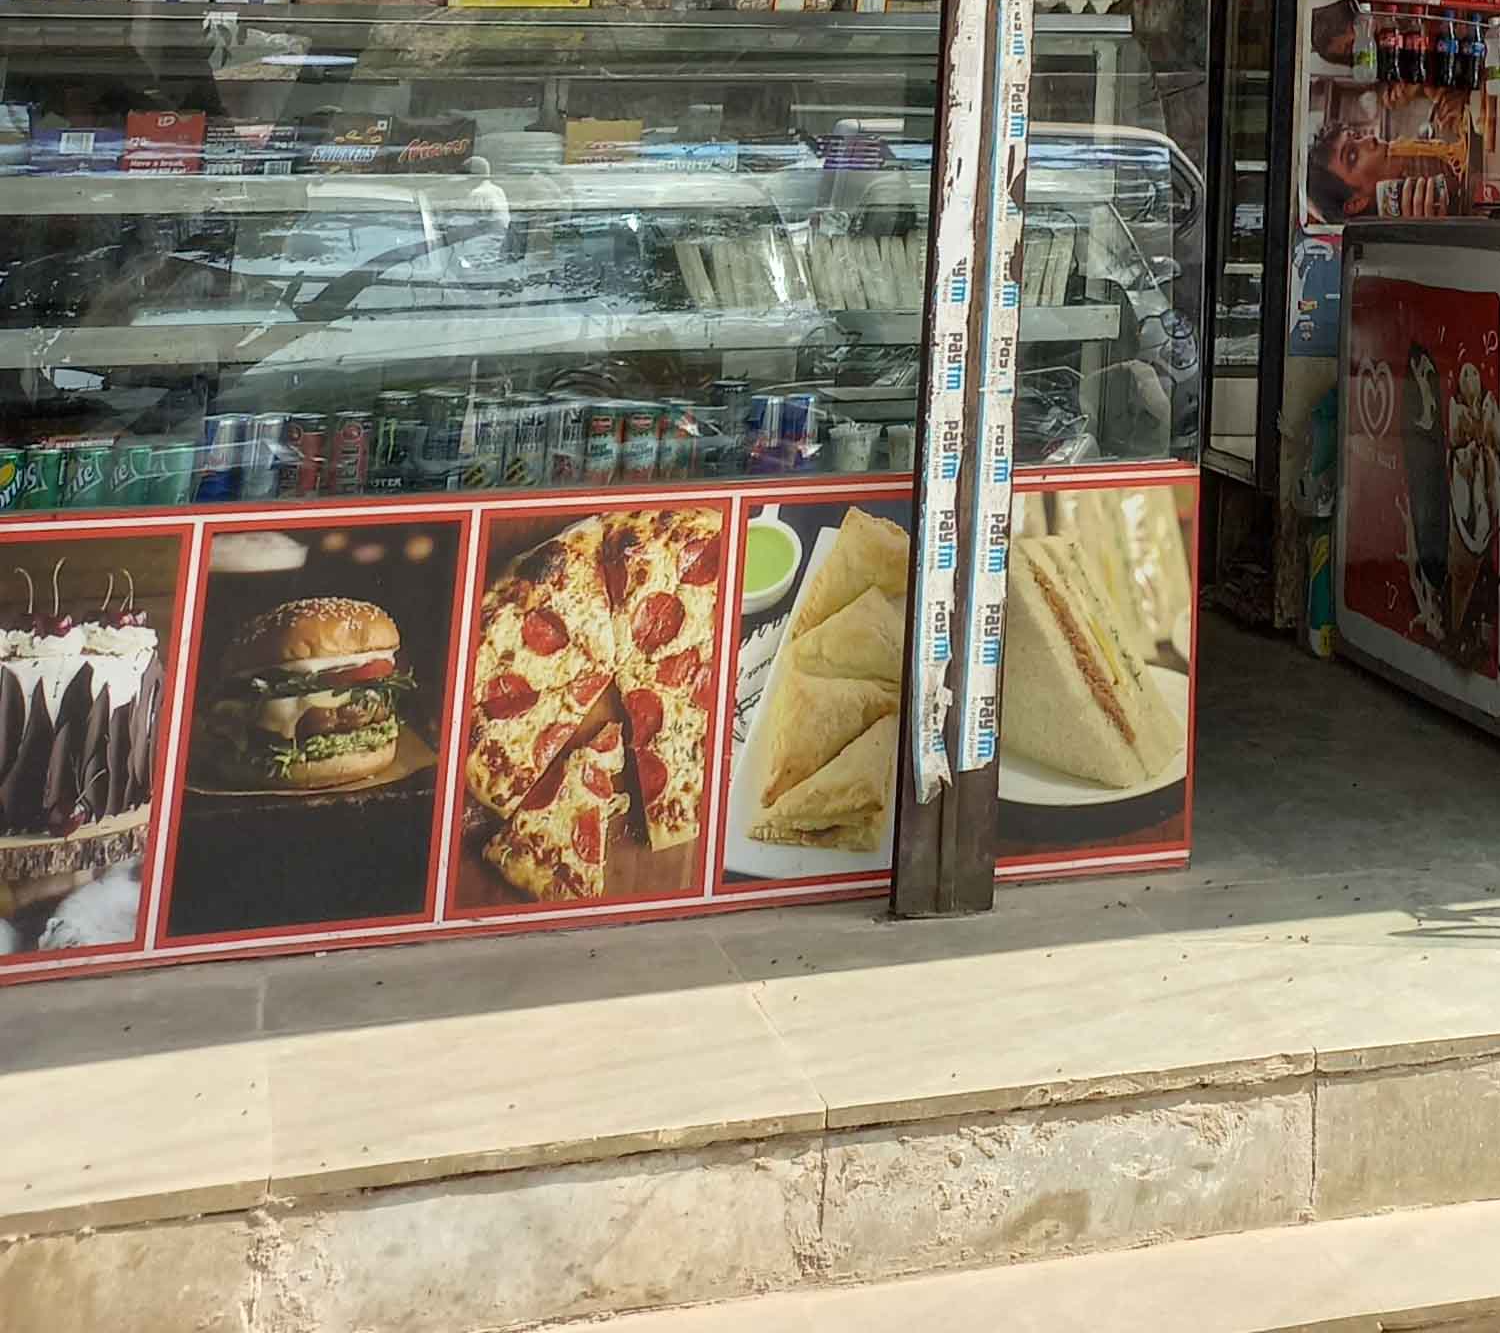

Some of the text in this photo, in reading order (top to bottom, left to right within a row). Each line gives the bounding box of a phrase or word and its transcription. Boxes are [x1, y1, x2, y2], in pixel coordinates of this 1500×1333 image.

[1008, 82, 1026, 139] Paytm
[950, 257, 967, 304] aytm
[945, 332, 963, 391] Paytm
[941, 420, 959, 479] Paytm
[938, 509, 956, 571] Paytm
[987, 513, 1008, 574] Paytm
[982, 603, 1000, 666] Paytm
[977, 695, 995, 759] Paytm
